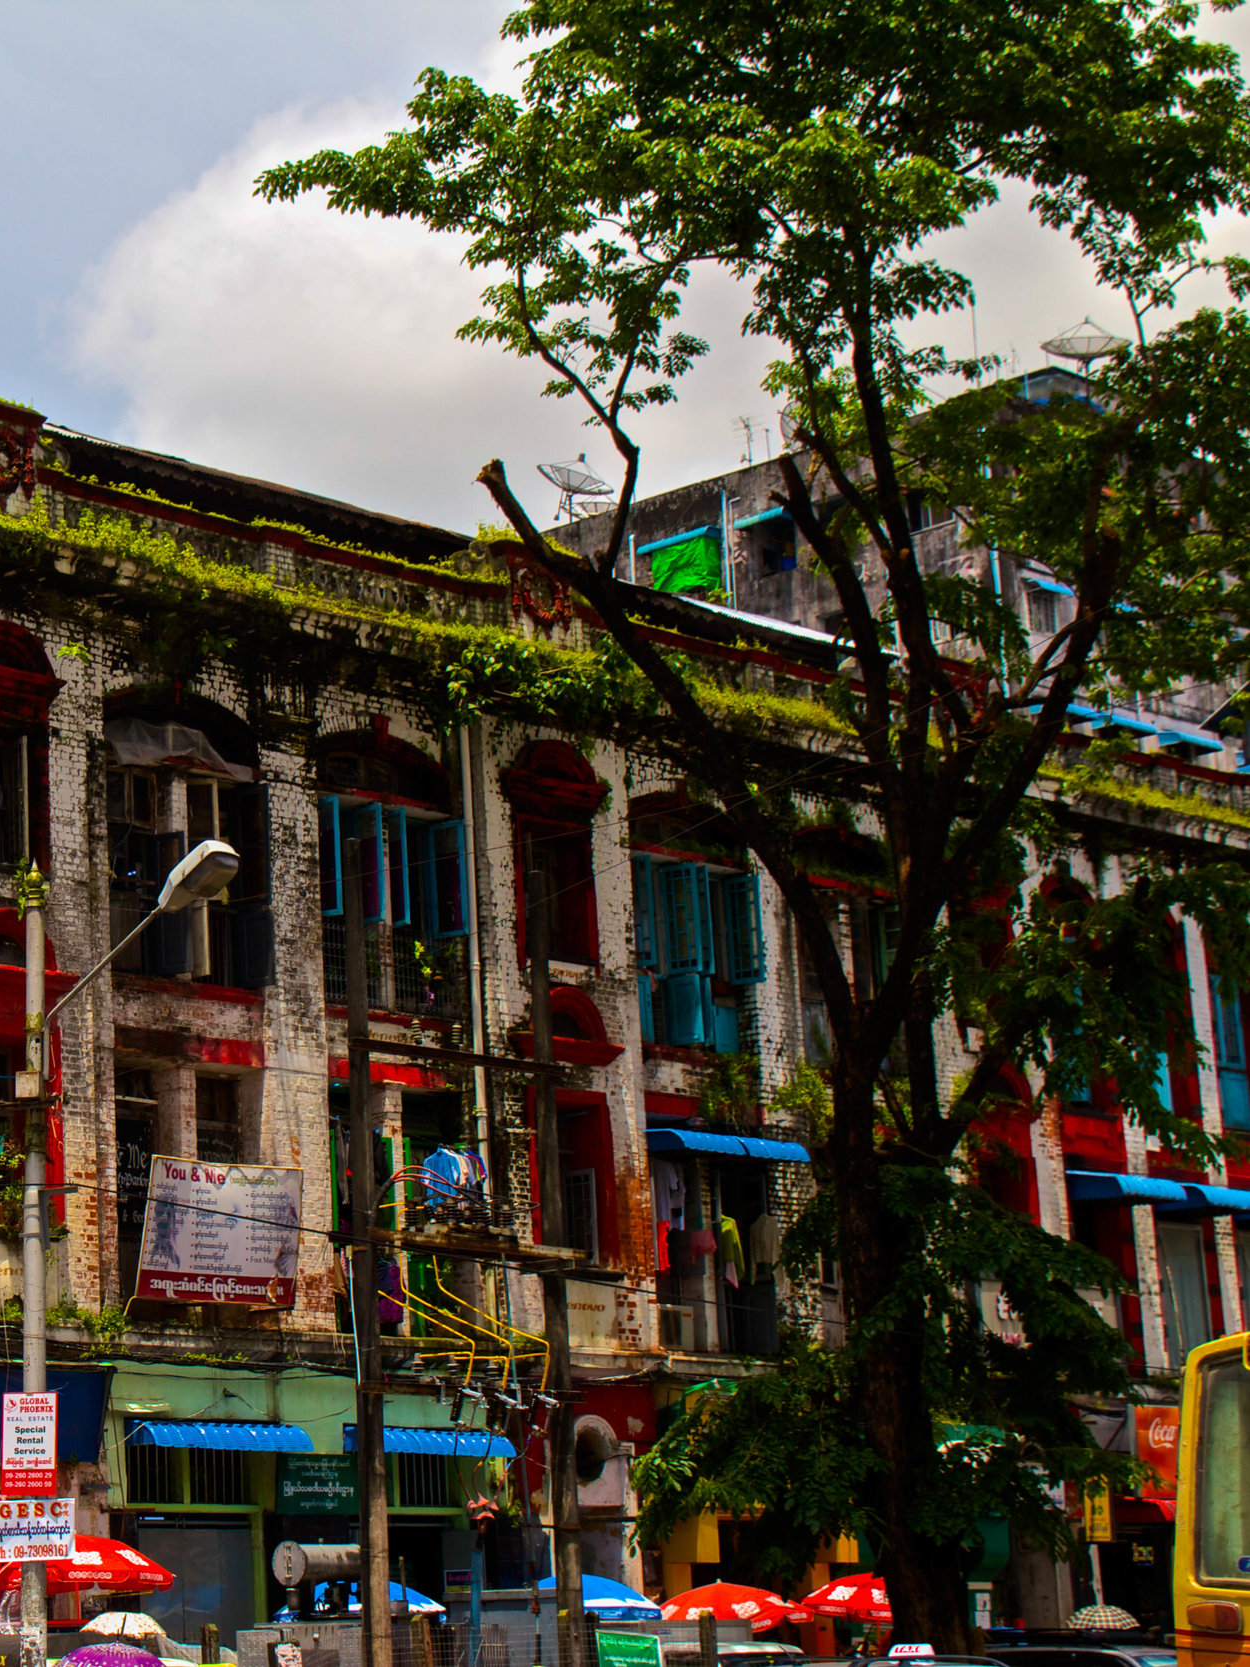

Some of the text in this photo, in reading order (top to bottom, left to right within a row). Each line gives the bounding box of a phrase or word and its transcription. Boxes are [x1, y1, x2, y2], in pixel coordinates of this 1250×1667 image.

[164, 1163, 187, 1181] You
[190, 1167, 201, 1182] &
[19, 1397, 50, 1405] GLOBAL
[19, 1405, 54, 1413] PHOENIX
[14, 1426, 46, 1435] Special
[1149, 1417, 1178, 1448] Coca
[16, 1436, 44, 1444] Rental
[13, 1447, 46, 1455] Service
[14, 1544, 69, 1559] 09-73098161
